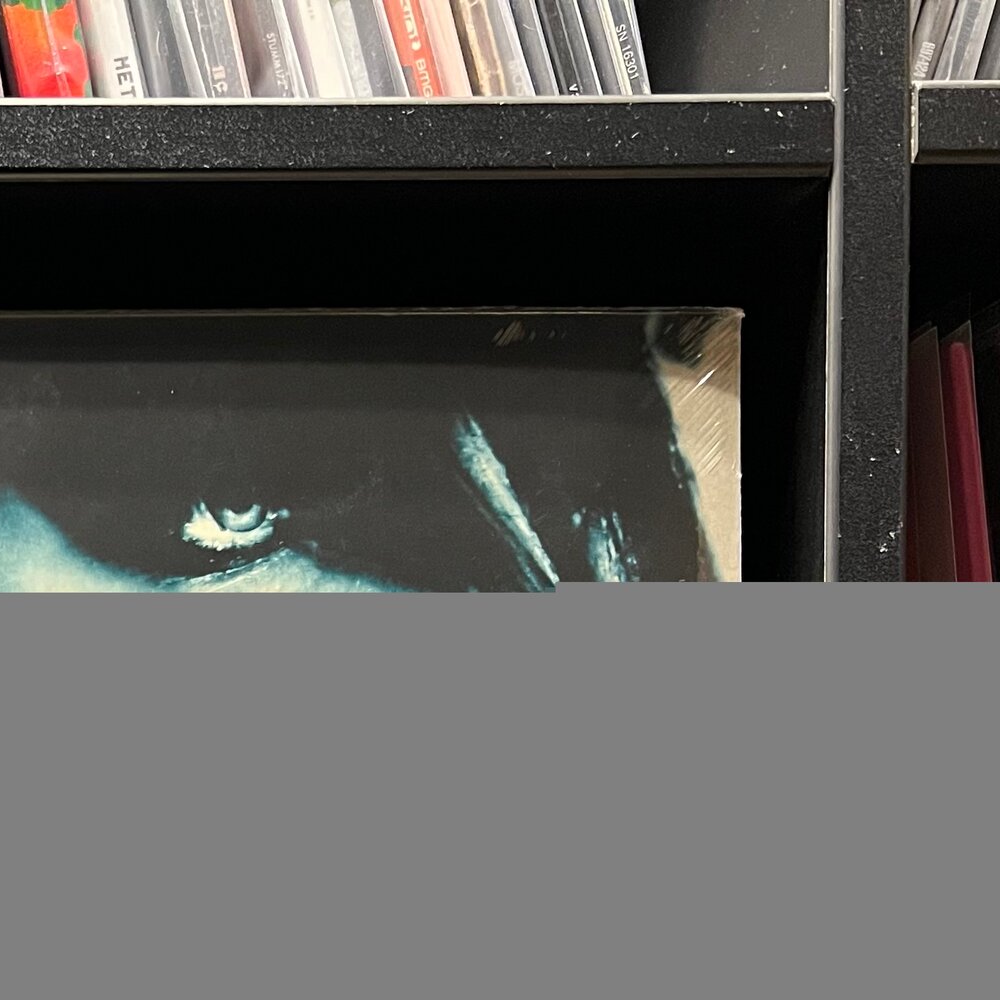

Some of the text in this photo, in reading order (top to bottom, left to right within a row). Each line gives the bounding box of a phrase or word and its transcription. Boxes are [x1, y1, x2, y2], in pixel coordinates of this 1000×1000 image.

[615, 24, 640, 80] SN 16301
[114, 55, 137, 97] HET
[415, 58, 434, 97] BMG
